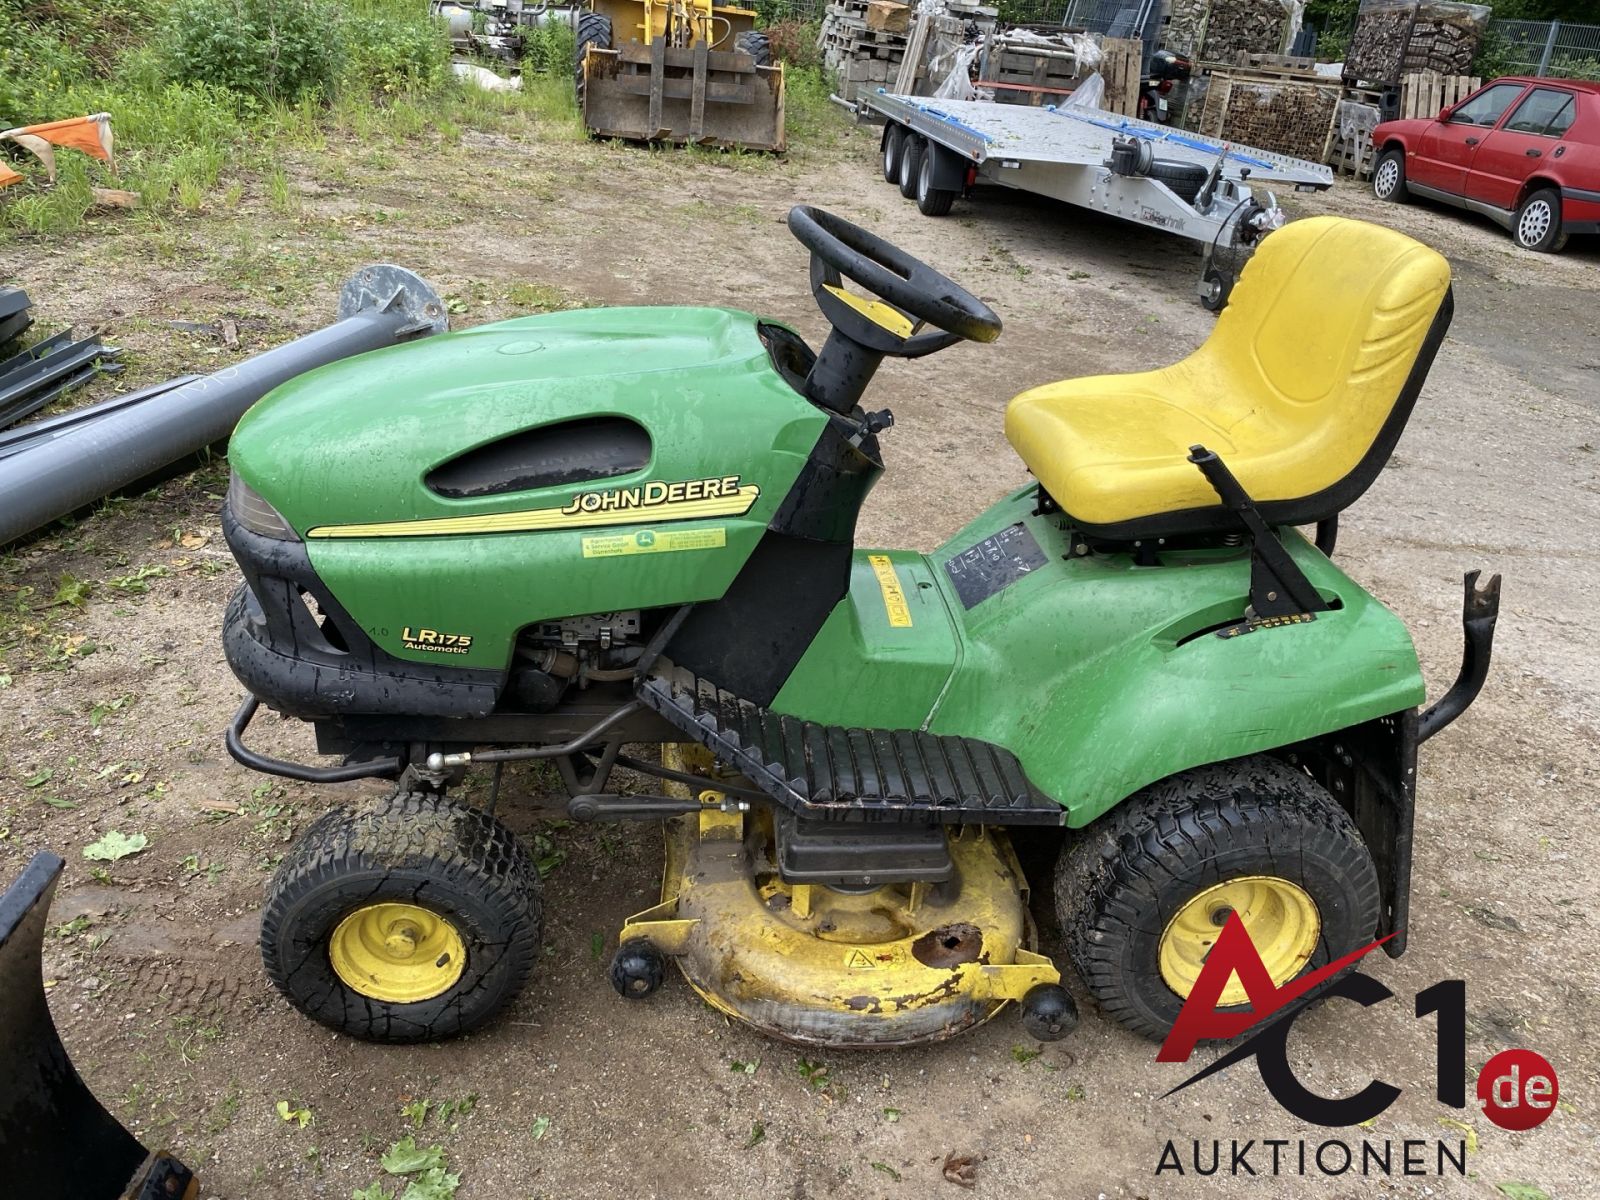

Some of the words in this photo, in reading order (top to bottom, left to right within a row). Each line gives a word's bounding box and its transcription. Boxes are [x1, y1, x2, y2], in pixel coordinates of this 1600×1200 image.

[562, 488, 640, 514] JOHN
[643, 475, 741, 506] DEERE
[402, 627, 472, 646] LR175
[404, 641, 469, 654] Automatic
